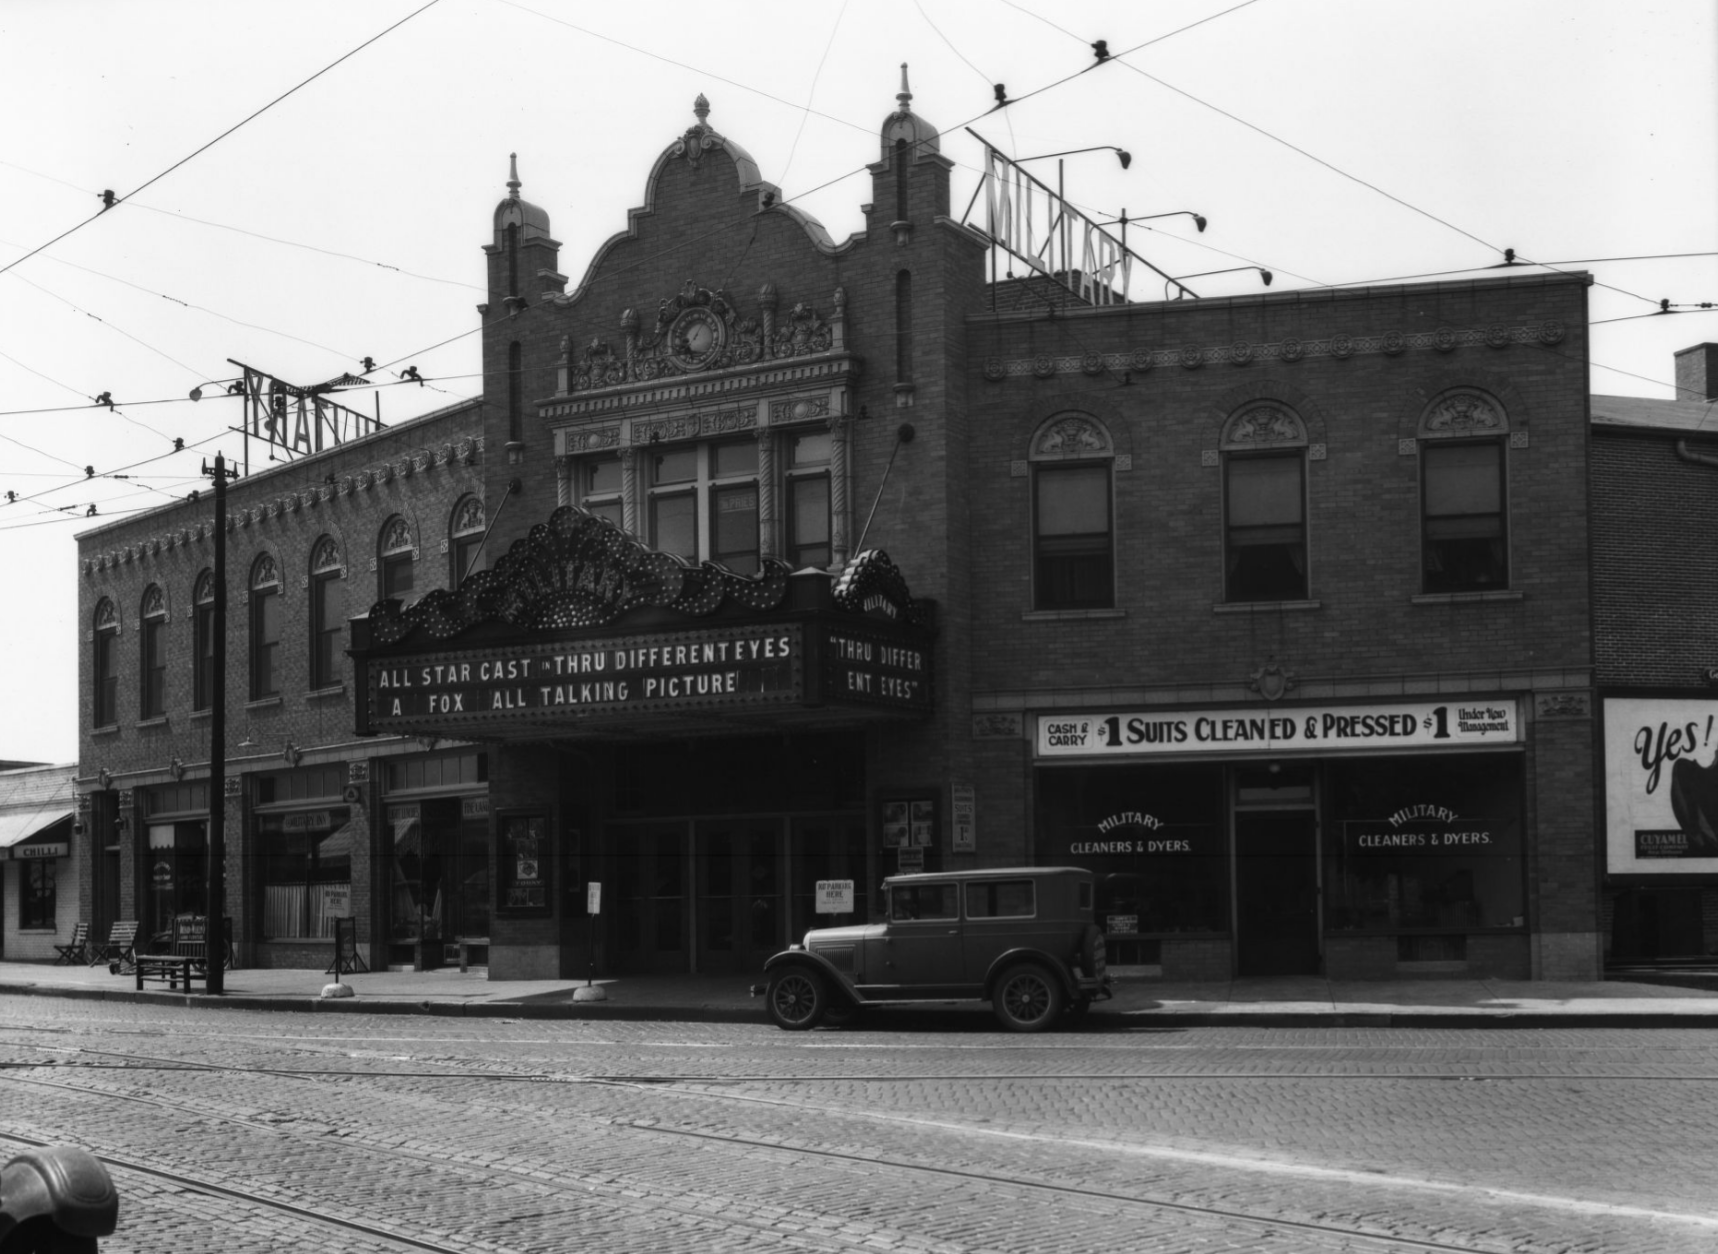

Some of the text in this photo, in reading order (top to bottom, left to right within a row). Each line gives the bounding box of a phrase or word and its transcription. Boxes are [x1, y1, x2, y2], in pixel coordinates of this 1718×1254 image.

[984, 143, 1133, 306] MILITARY
[864, 594, 898, 619] MILITARY
[379, 670, 411, 688] ALL
[422, 663, 470, 686] STAR
[480, 659, 530, 681] CAST
[554, 651, 605, 675] THRU
[615, 642, 729, 671] DIFFERENT
[734, 637, 790, 661] EYES
[881, 645, 921, 671] DIFFER
[847, 671, 872, 693] ENT
[392, 672, 736, 716] A FOX ALL TALKING PICTURE
[1458, 708, 1485, 721] Under
[1048, 724, 1077, 735] CASH
[1127, 718, 1188, 744] SUITS
[1194, 717, 1296, 742] CLEANED
[1304, 716, 1318, 739] &
[1322, 713, 1417, 739] PRESSED
[1458, 720, 1510, 736] Management
[1048, 734, 1088, 747] CARRY
[1634, 714, 1714, 795] Yes!
[1097, 811, 1165, 834] MILITARY
[1388, 804, 1459, 828] MILITARY
[1070, 841, 1132, 854] CLEANERS
[1136, 841, 1144, 853] &
[1358, 834, 1426, 847] CLEANERS
[1431, 833, 1439, 846] &
[1640, 833, 1689, 845] CUYAMEL
[23, 846, 58, 857] CHILLI
